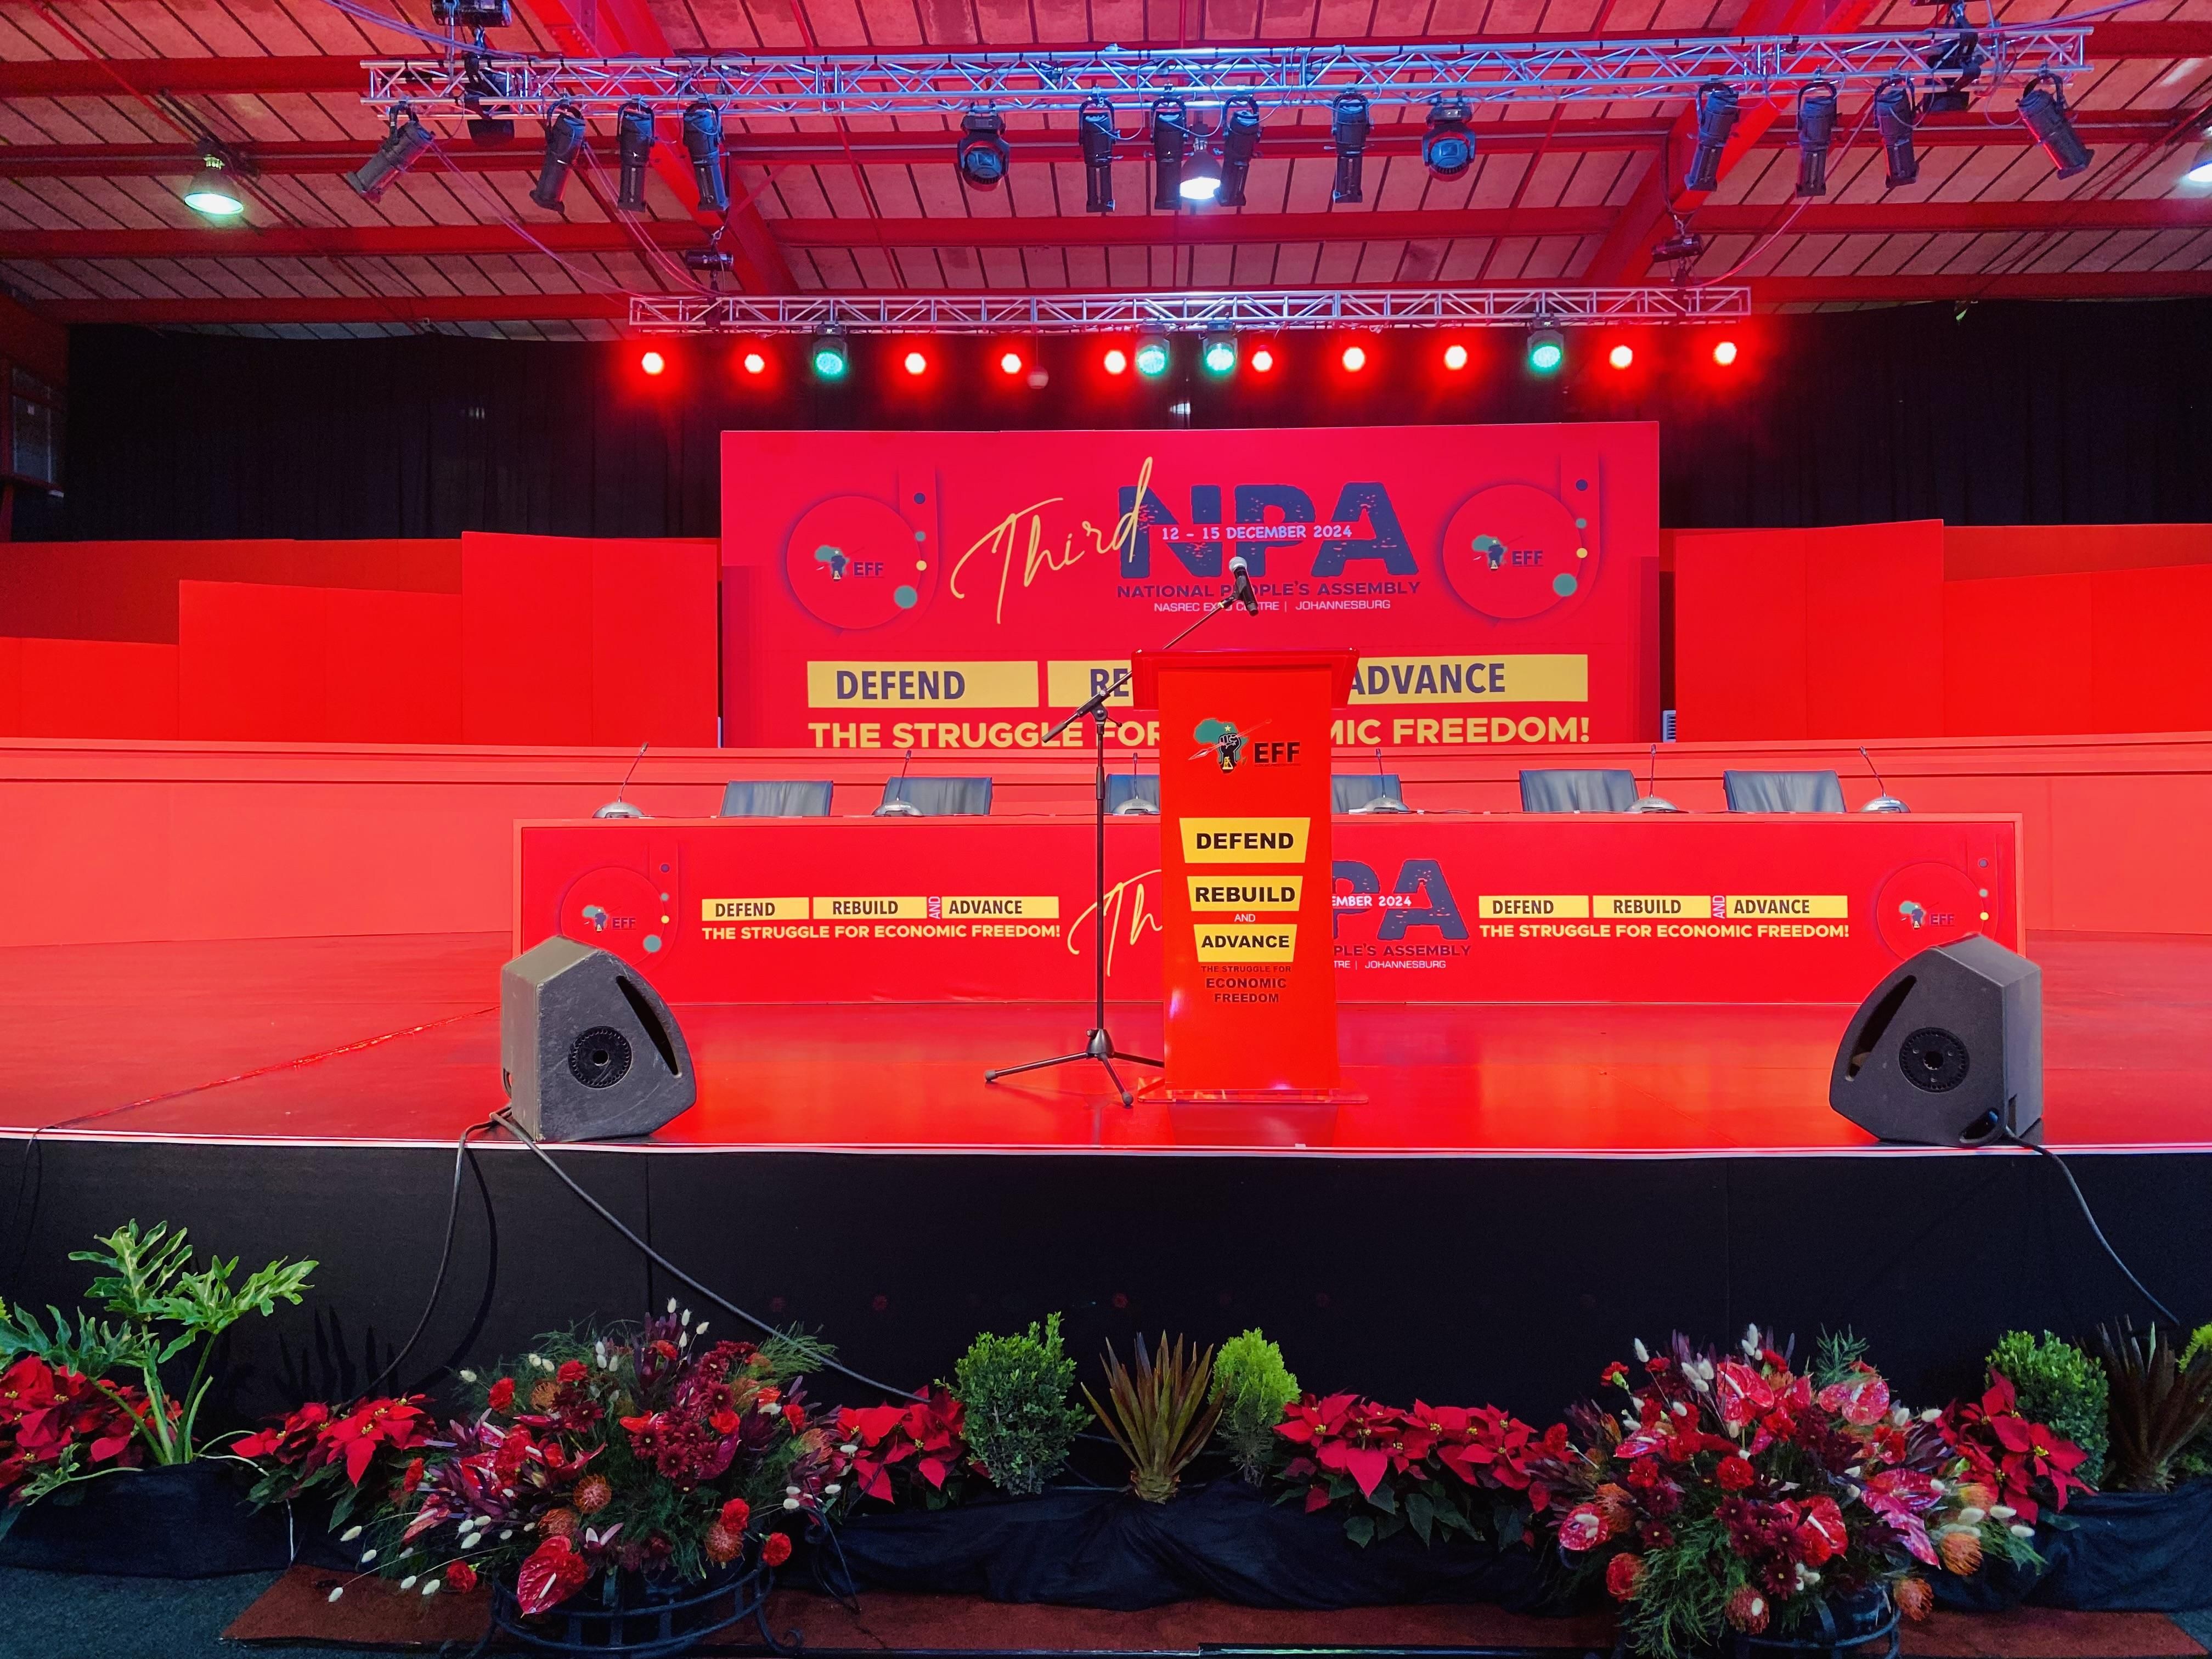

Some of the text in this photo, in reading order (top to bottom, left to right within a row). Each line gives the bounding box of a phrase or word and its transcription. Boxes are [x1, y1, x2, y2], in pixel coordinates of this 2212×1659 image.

[1162, 527, 1179, 540] 12
[1203, 527, 1220, 539] 15
[1226, 526, 1306, 539] DECEMBER
[1314, 524, 1352, 538] 2024
[950, 456, 1419, 624] Third NPA
[1512, 550, 1543, 565] EFF
[854, 562, 884, 575] EFF
[1117, 585, 1214, 599] NATIONAL
[1317, 582, 1421, 596] ASSEMBLY
[1154, 601, 1200, 612] NASREC
[1236, 601, 1279, 611] CTRE
[1295, 600, 1391, 611] JOHANNESBURG
[837, 670, 966, 700] DEFEND
[809, 723, 881, 748] THE
[1393, 716, 1589, 744] FREEDOM!
[1254, 742, 1301, 763] EFF
[1196, 832, 1294, 849] DEFEND
[1195, 886, 1296, 902] REBUILD
[1332, 859, 1470, 940] PA
[1379, 895, 1412, 907] 2024
[715, 896, 1023, 919] DEFEND REBUILD AND ADVANCE
[1492, 895, 1810, 919] DEFEND REBUILD AND ADVANCE
[612, 917, 636, 928] EFF
[1234, 913, 1256, 922] AND
[1931, 914, 1954, 924] EFF
[702, 923, 1060, 940] THE STRUGGLE FOR ECONOMIC FREEDOM!
[1479, 924, 1850, 938] THE STRUGGLE FOR ECONOMIC FREEDOM!
[1201, 934, 1290, 949] ADVANCE
[1334, 943, 1471, 956] PLE'S ASSEMBLY
[1364, 960, 1446, 968] JOHANNESBURG
[1206, 978, 1287, 989] ECONOMIC
[1214, 993, 1279, 1003] FREEDOM
